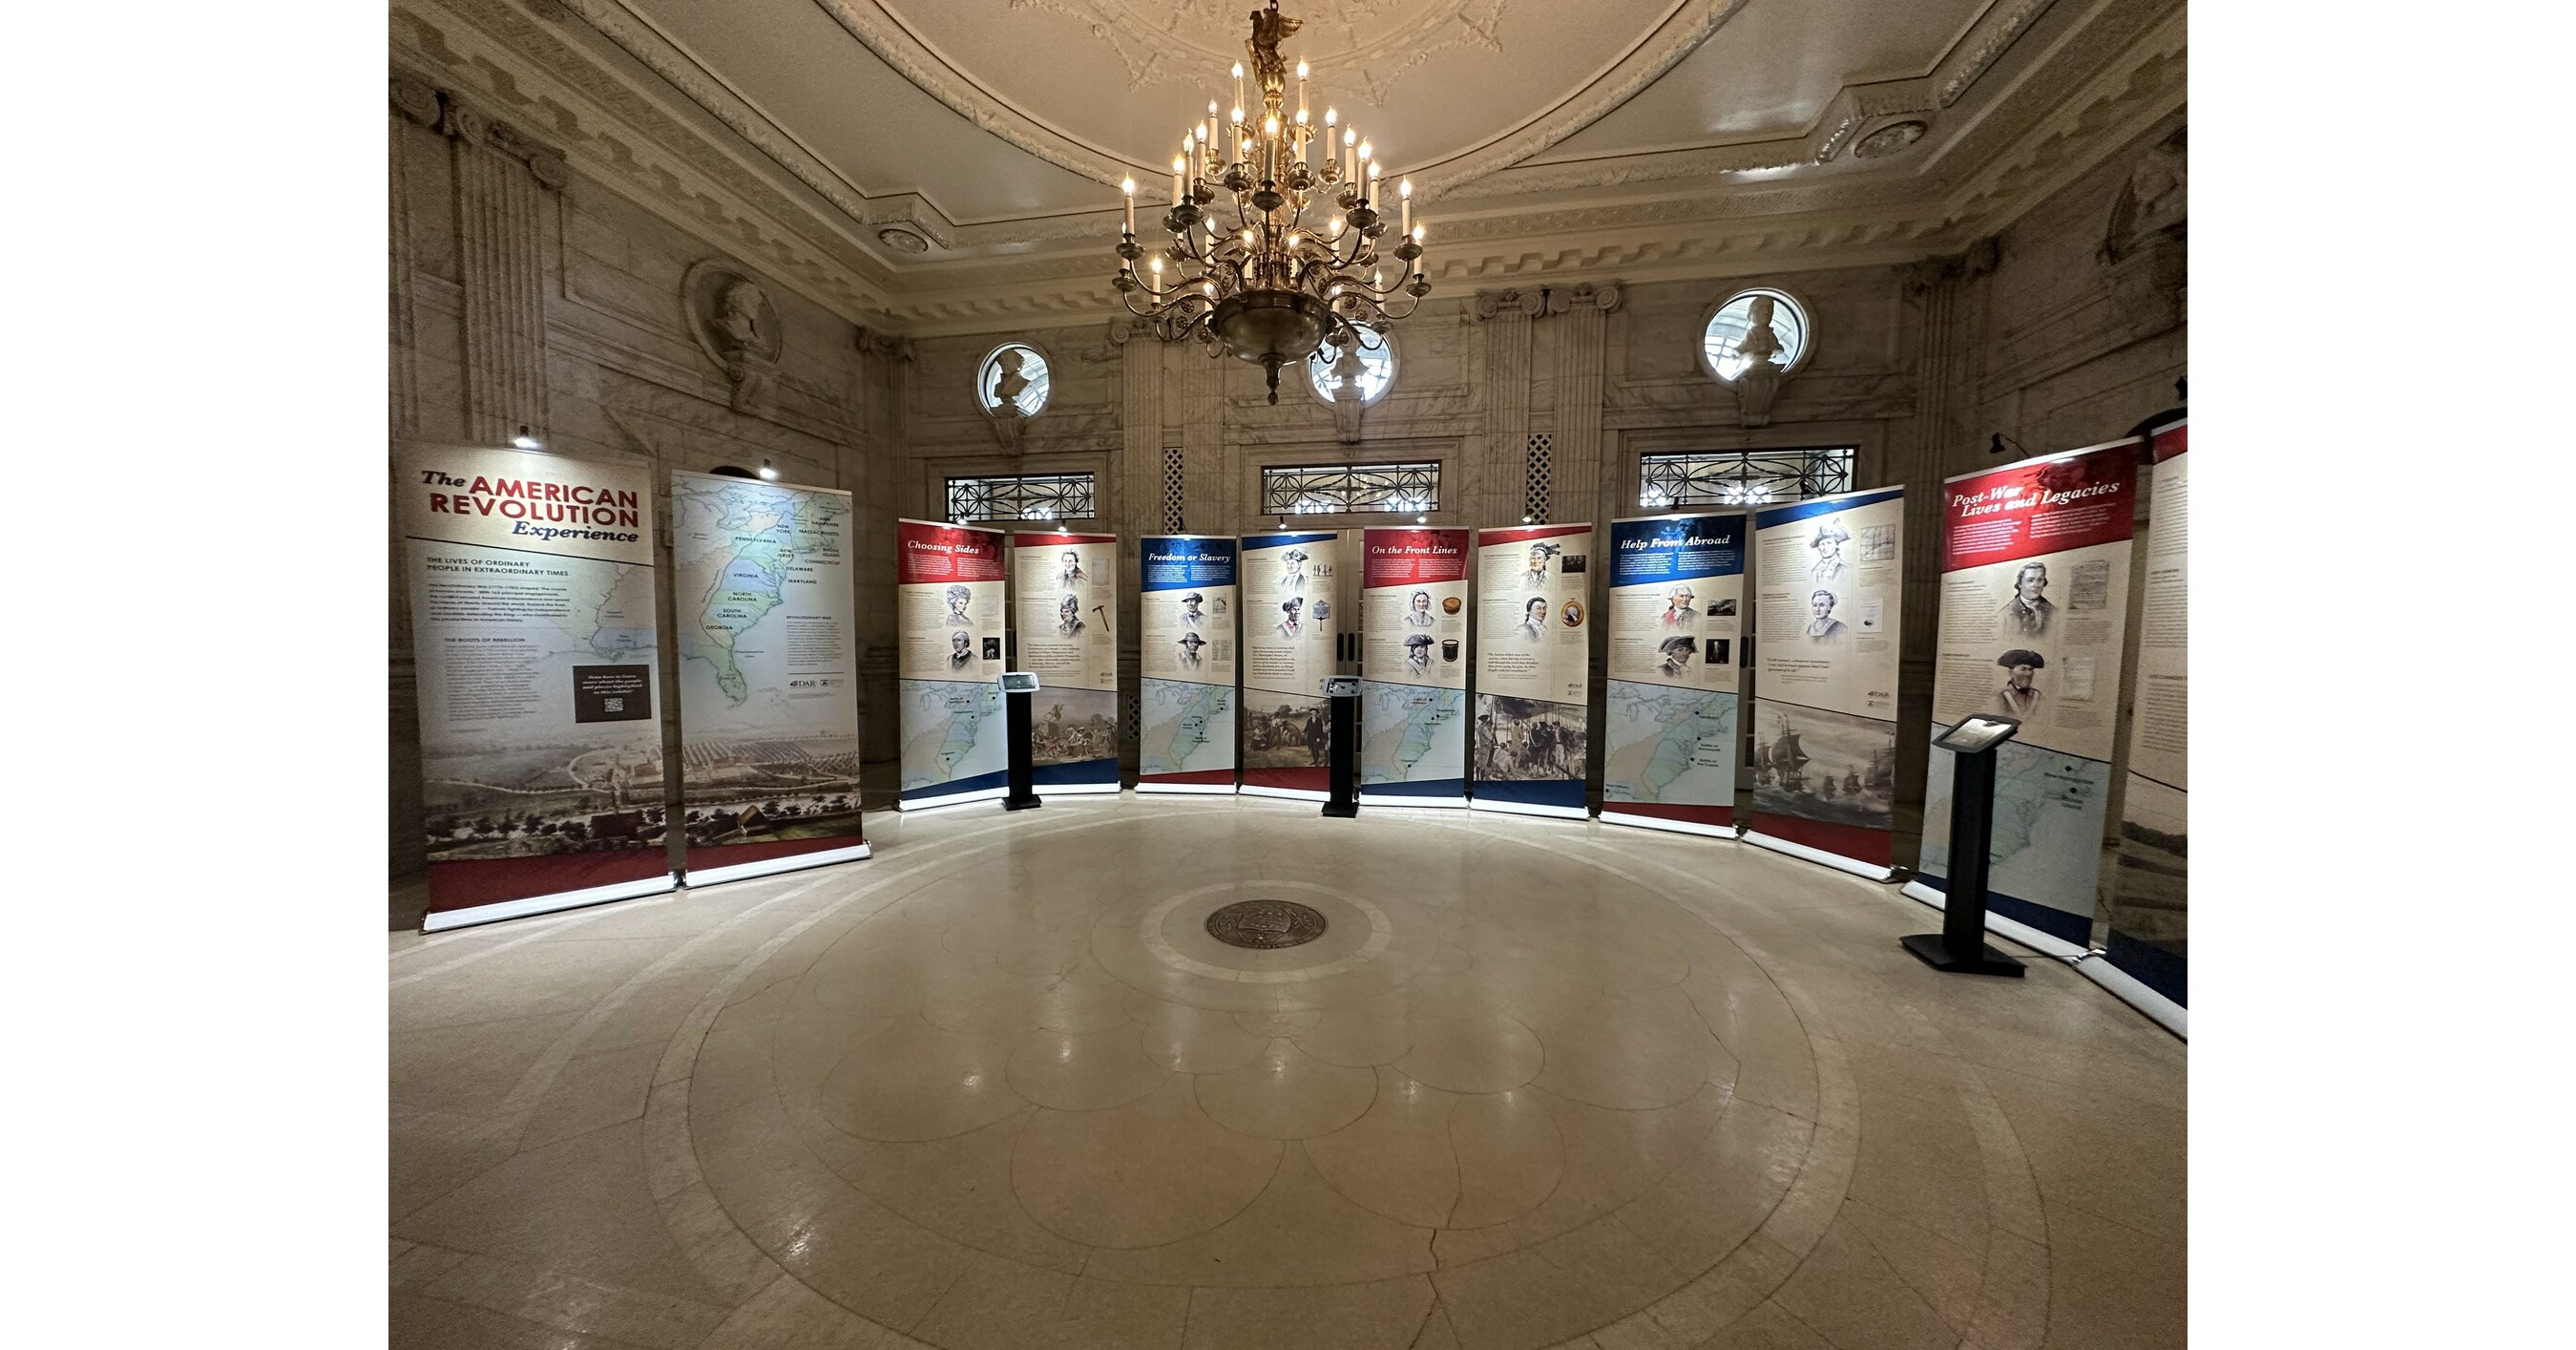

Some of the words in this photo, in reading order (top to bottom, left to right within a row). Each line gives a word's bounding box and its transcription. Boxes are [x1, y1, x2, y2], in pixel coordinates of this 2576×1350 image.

[422, 471, 466, 487] The
[469, 475, 638, 509] AMERICAN
[1953, 485, 2025, 507] Post-War
[1961, 503, 2002, 517] Lives
[2004, 492, 2038, 511] and
[2040, 481, 2121, 505] Legacies
[429, 492, 639, 527] REVOLUTION
[512, 520, 639, 542] Experience
[908, 540, 953, 554] Choosing
[954, 543, 979, 554] Sides
[1372, 545, 1386, 554] On
[1388, 545, 1403, 554] the
[1405, 545, 1431, 554] Front
[1433, 545, 1457, 554] Lines
[1621, 539, 1648, 551] Help
[1650, 538, 1684, 548] From
[1685, 534, 1731, 546] Abroad
[1148, 553, 1186, 561] Freedom
[1199, 553, 1231, 563] Slavery
[474, 566, 544, 576] EXTRAORDINARY
